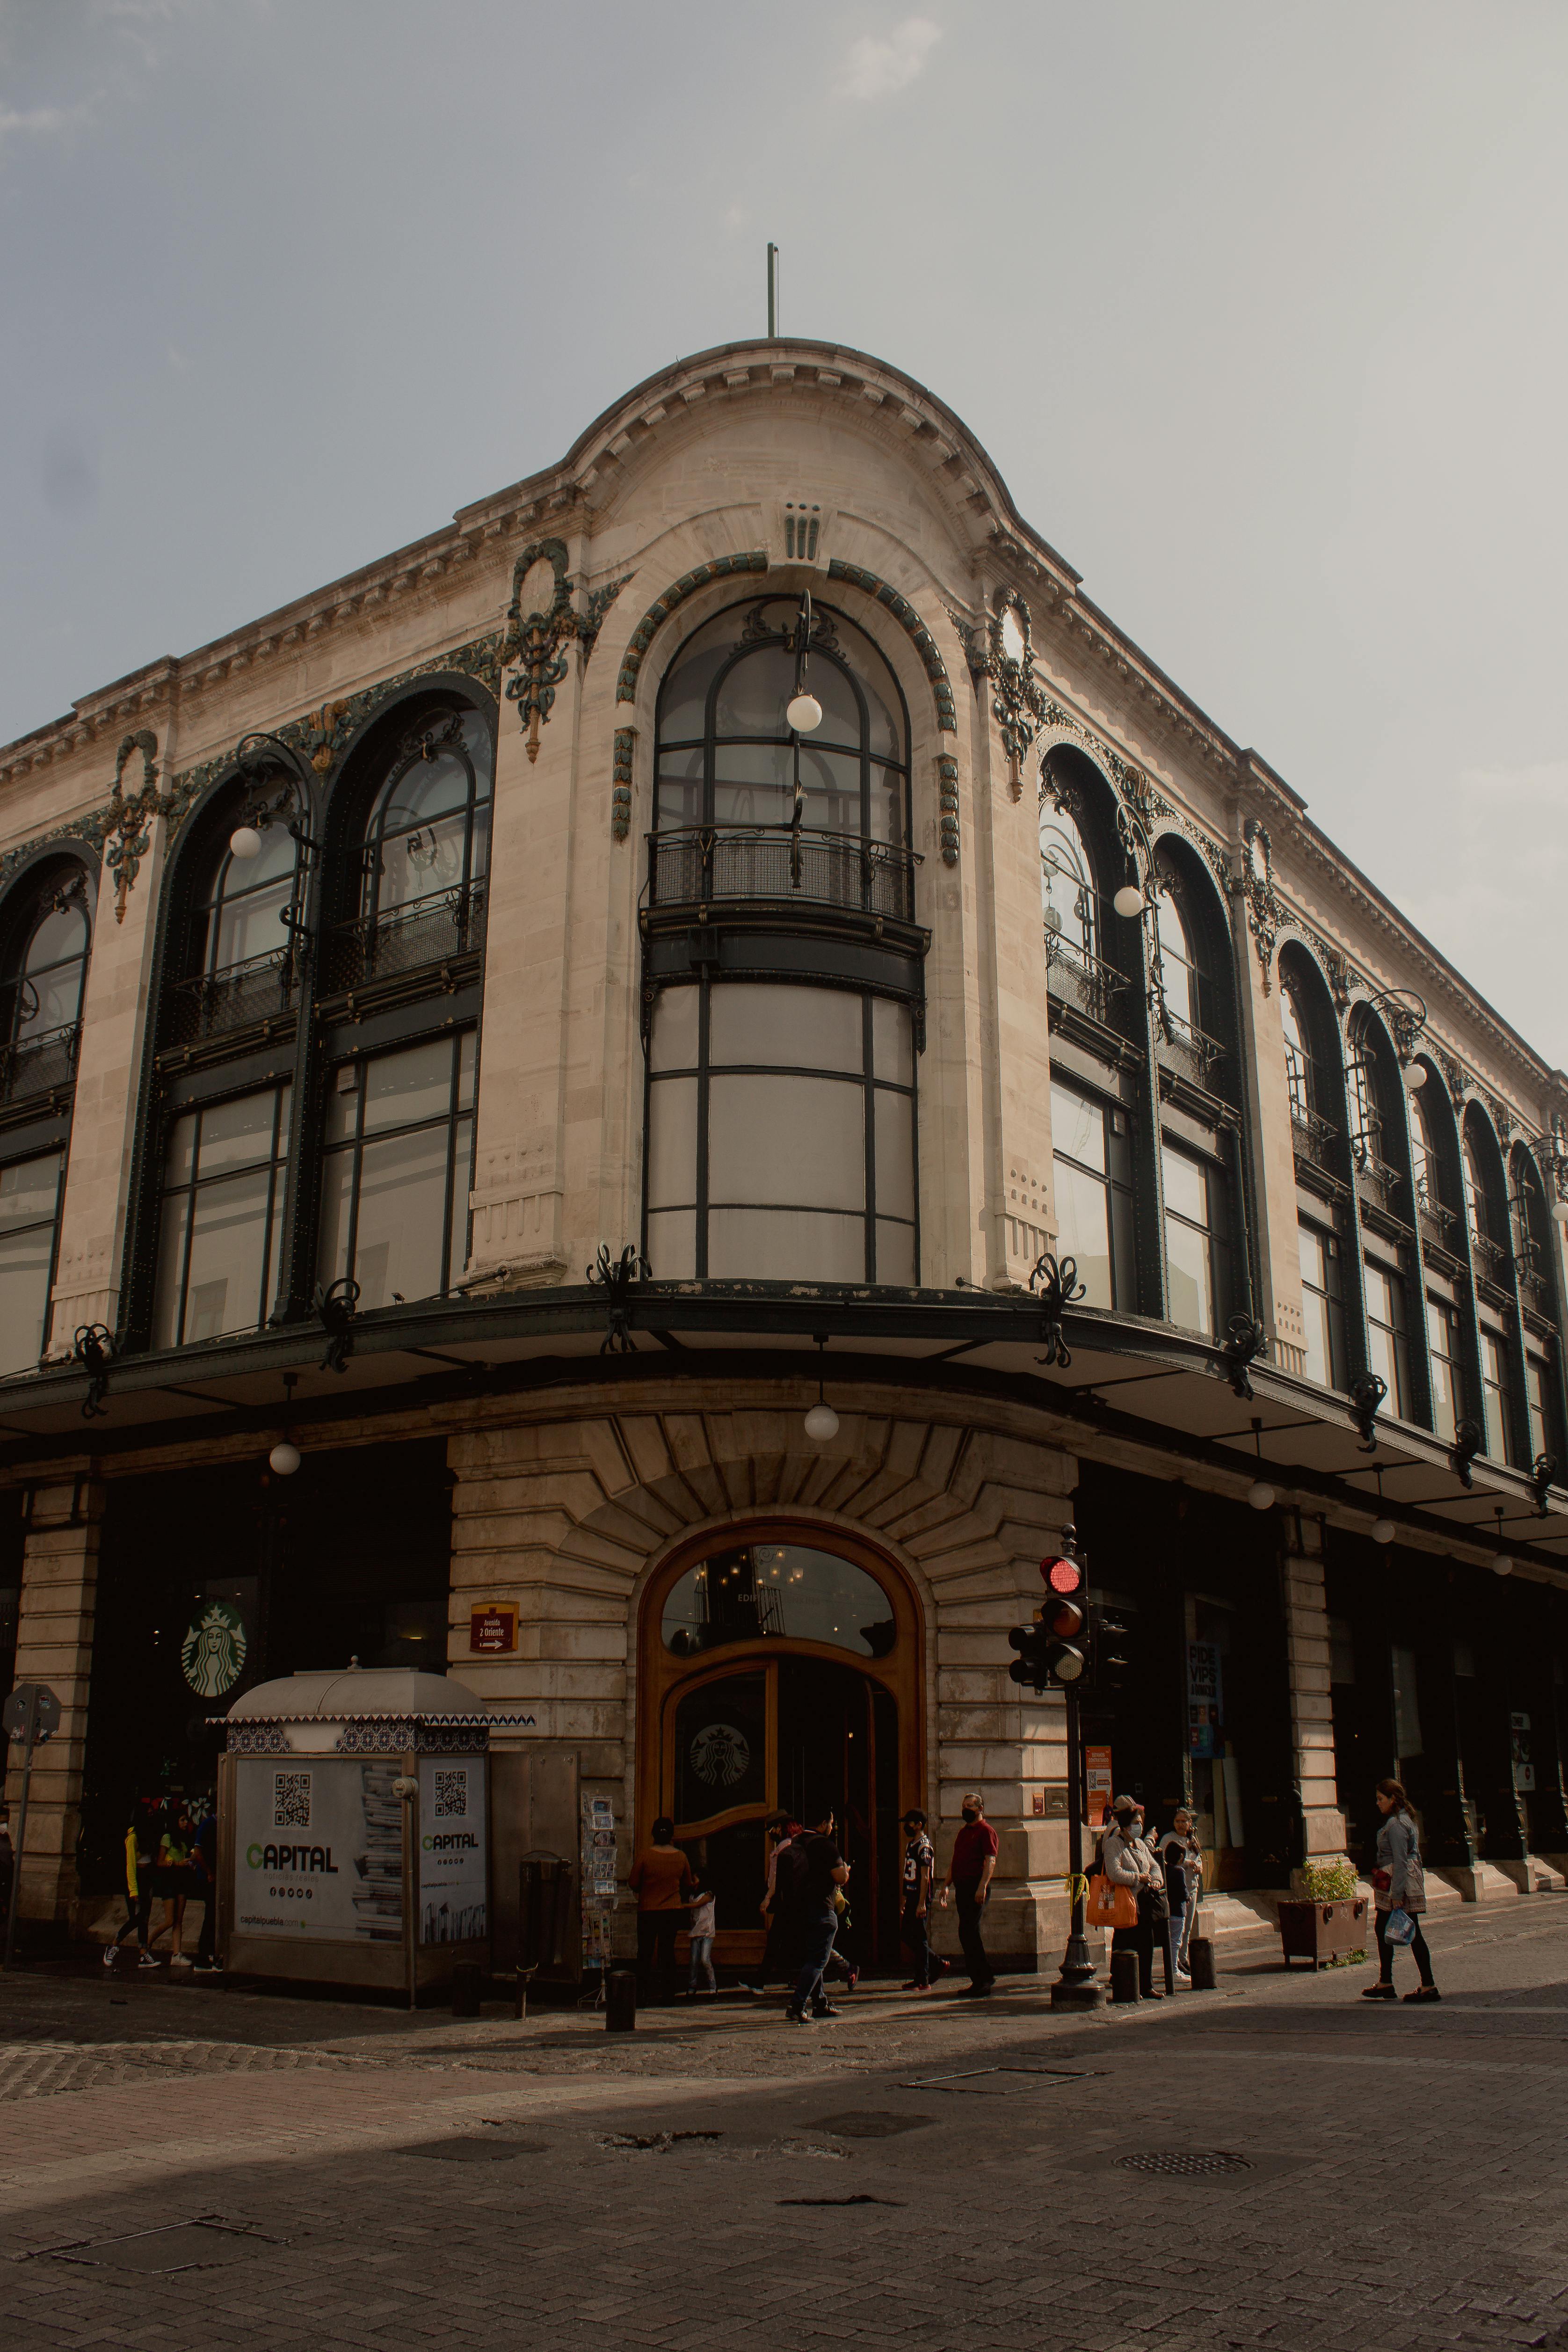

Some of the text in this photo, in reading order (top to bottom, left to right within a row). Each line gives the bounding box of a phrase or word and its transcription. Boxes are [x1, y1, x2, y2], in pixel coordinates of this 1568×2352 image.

[479, 1628, 504, 1637] 2 Oriente
[1190, 1646, 1215, 1665] PIDE
[1190, 1665, 1217, 1683] VIPS
[422, 1833, 479, 1851] CAPITAL
[247, 1843, 339, 1873] CAPITAL
[263, 1873, 319, 1883] noticias reales
[240, 1915, 299, 1927] capitalpuebla.com
